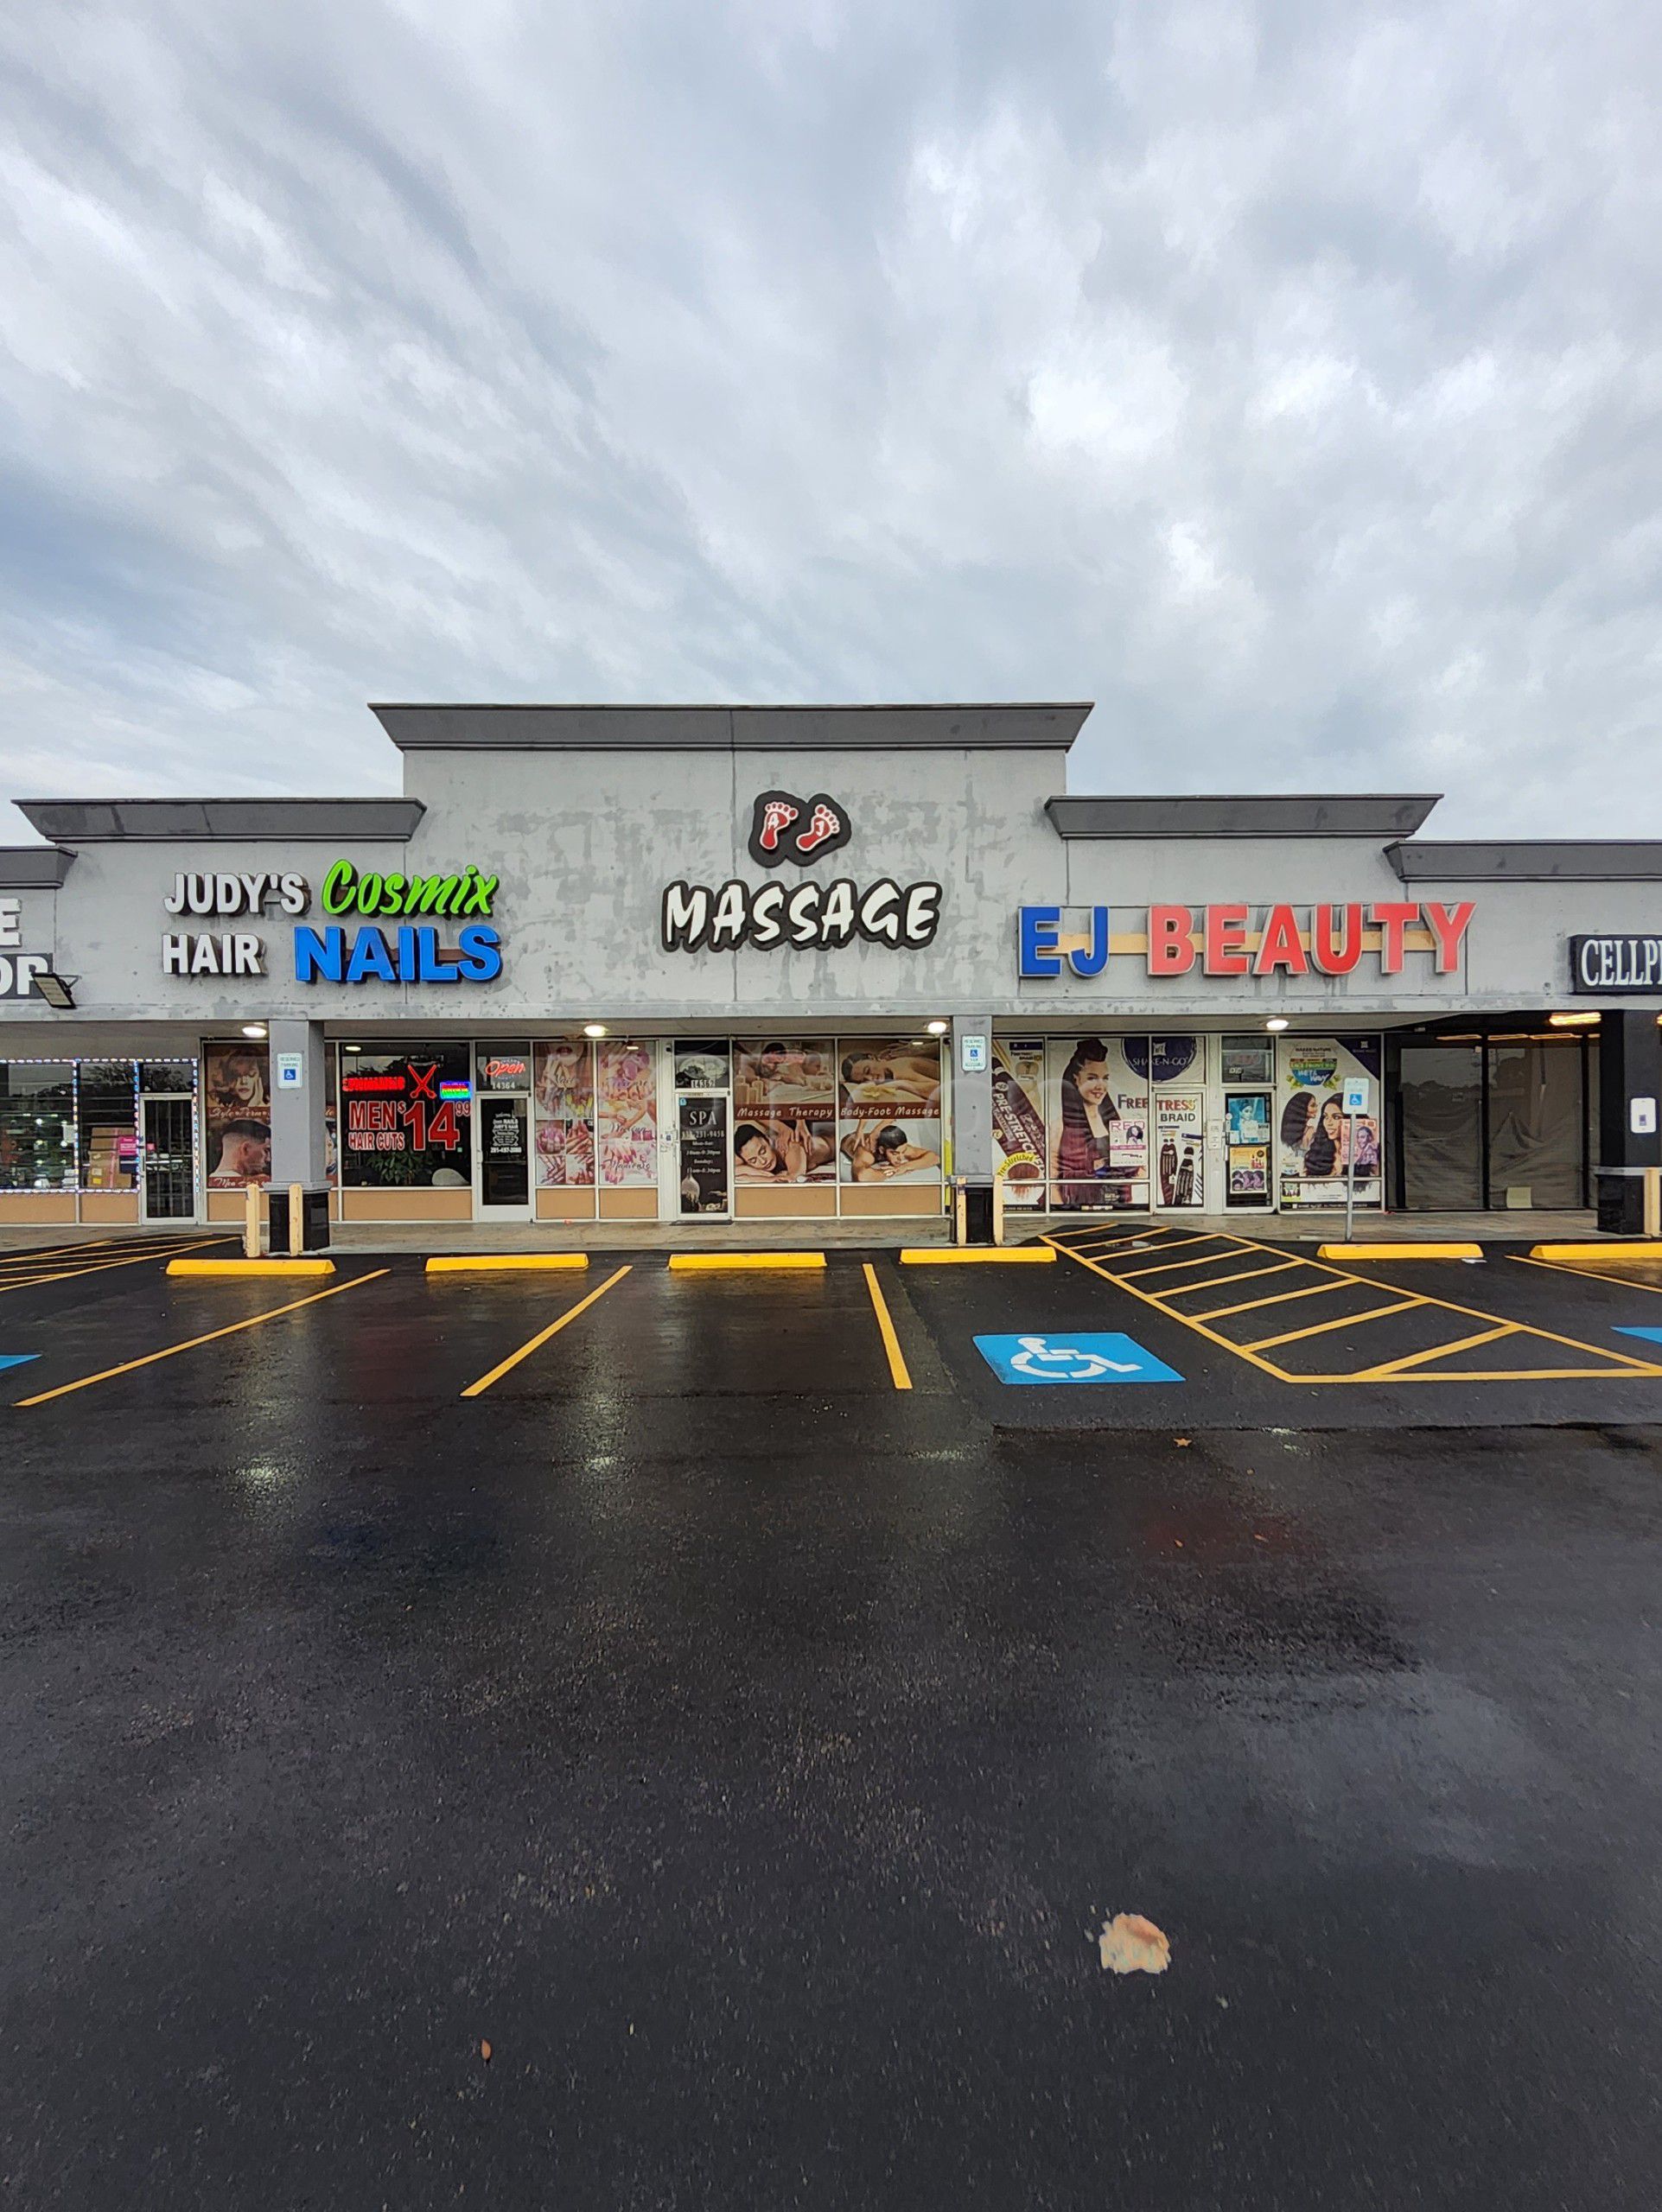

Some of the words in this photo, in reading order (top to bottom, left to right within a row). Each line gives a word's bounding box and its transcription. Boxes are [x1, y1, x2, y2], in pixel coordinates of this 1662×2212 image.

[164, 873, 307, 914] JUDY'S
[322, 859, 500, 915] Cosmix
[665, 881, 938, 944] MASSAGE
[162, 933, 264, 975] HAIR
[294, 925, 501, 982] NAILS
[1017, 906, 1110, 976] EJ
[1148, 902, 1477, 975] BEAUTY
[1582, 939, 1662, 986] CELLP
[485, 1060, 525, 1077] Open
[349, 1101, 398, 1130] MEN
[689, 1111, 716, 1125] SPA
[737, 1107, 782, 1119] Massage
[789, 1107, 833, 1119] Therapy
[841, 1106, 891, 1118] Body-Foot
[895, 1106, 940, 1118] Massage
[348, 1132, 375, 1150] HAIR
[376, 1132, 405, 1150] CUTS
